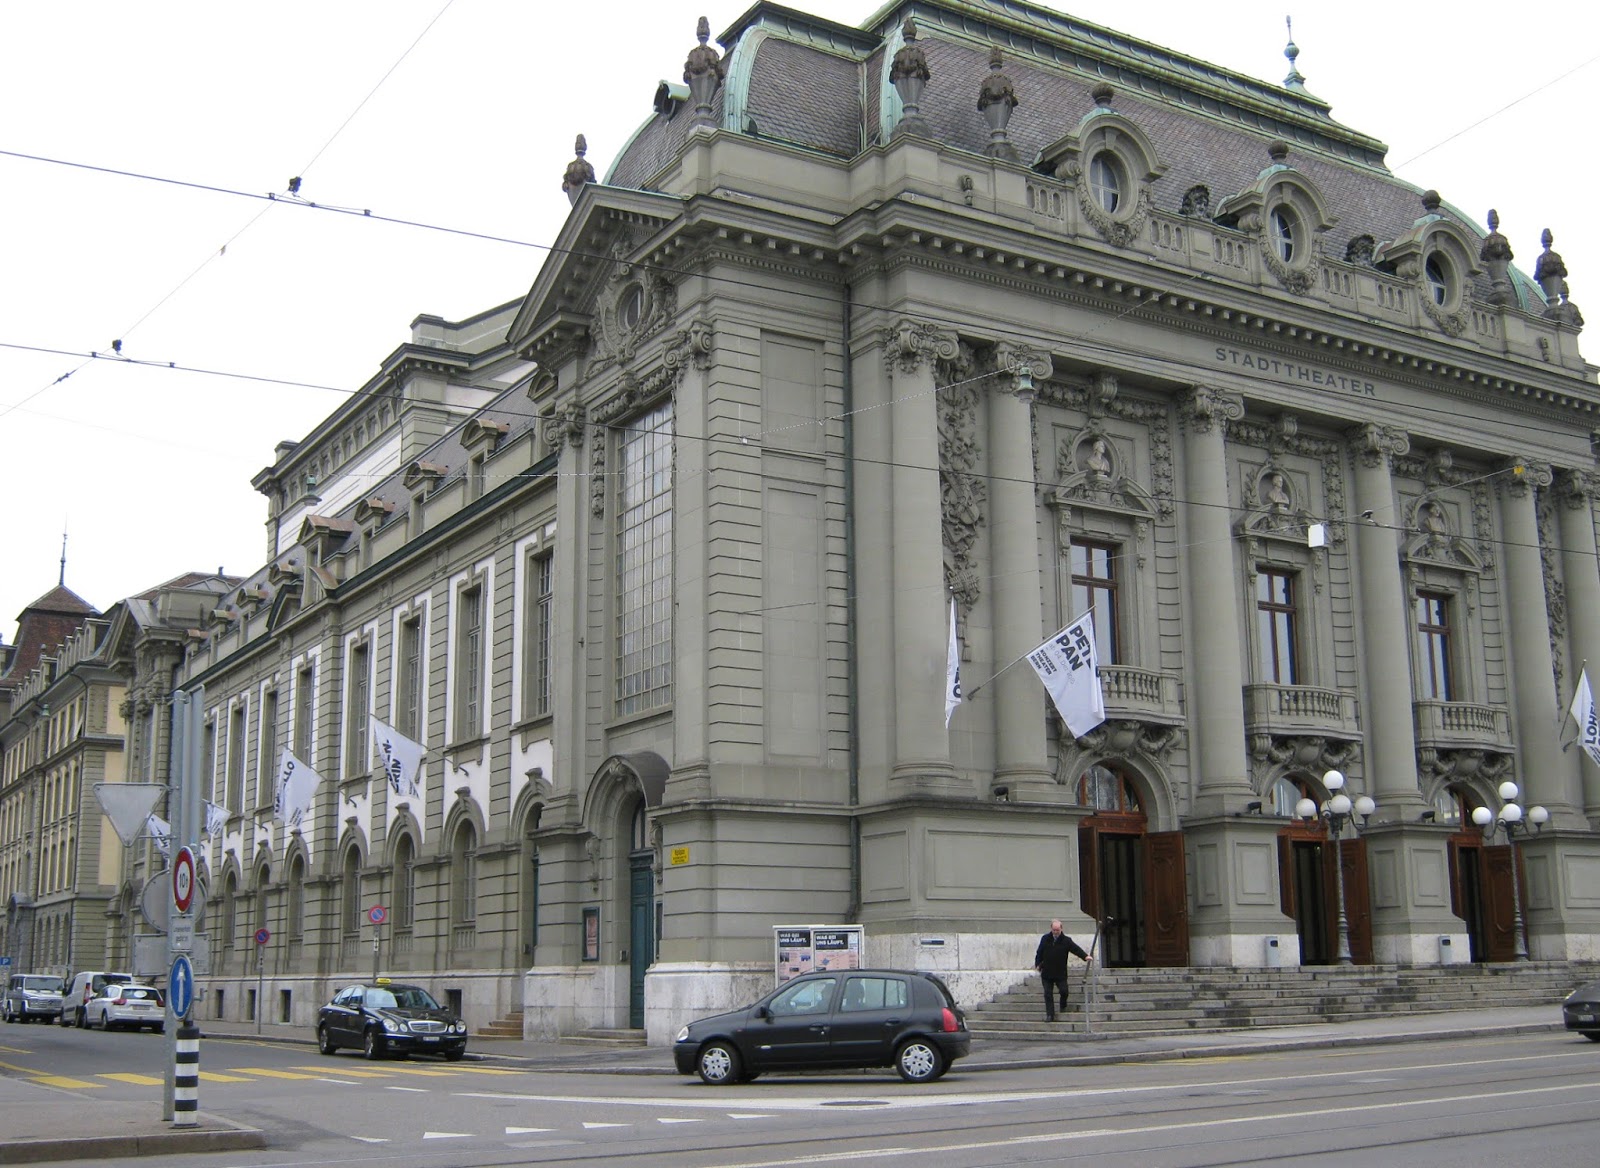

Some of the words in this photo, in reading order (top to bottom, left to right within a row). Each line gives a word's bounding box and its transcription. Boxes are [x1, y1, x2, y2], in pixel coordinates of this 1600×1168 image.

[1215, 348, 1376, 396] STADTTHEATER
[1030, 655, 1042, 670] BERN
[1035, 652, 1052, 675] THEATER
[1040, 649, 1057, 672] KONZERT
[1055, 634, 1084, 671] PAN
